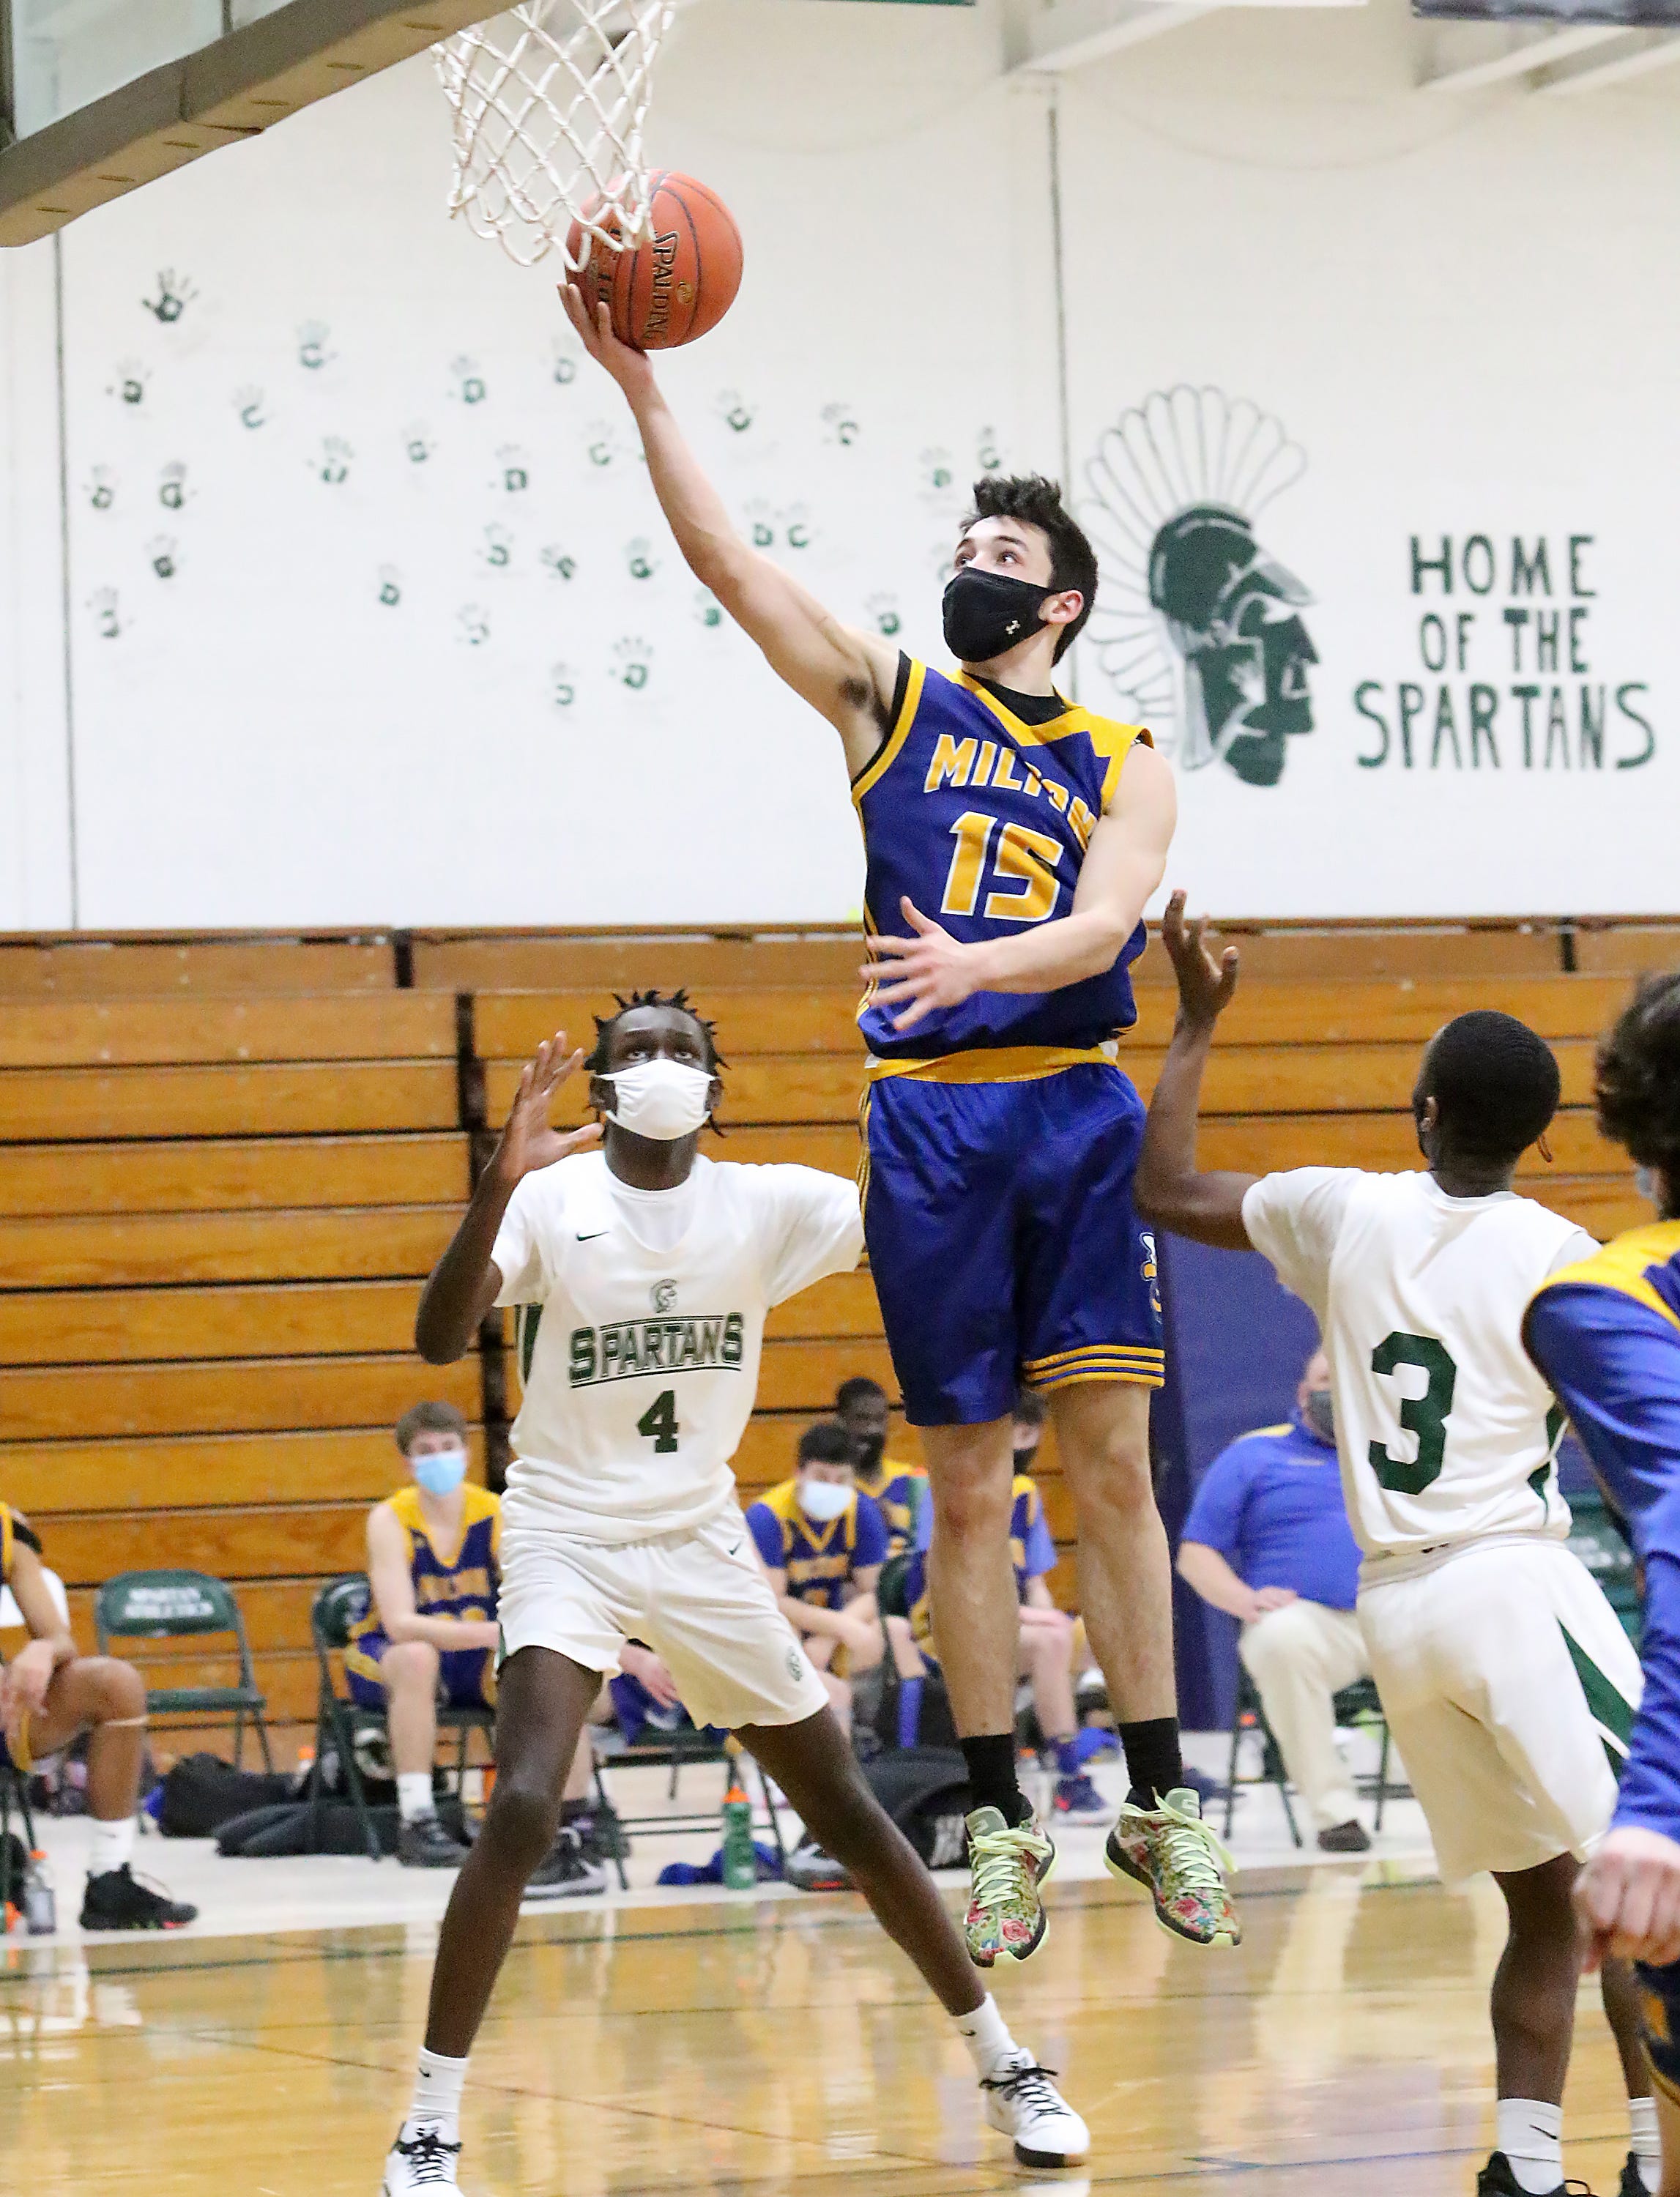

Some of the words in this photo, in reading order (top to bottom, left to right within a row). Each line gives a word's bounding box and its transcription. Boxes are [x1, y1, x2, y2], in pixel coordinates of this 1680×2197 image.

[1409, 534, 1597, 598] HOME
[1420, 612, 1476, 672] OF
[1503, 607, 1590, 673] THE
[1354, 680, 1657, 770] SPARTANS
[940, 811, 1064, 922] 15
[568, 1312, 743, 1383] SPARTANS
[636, 1389, 679, 1454] 4
[1368, 1331, 1457, 1495] 3
